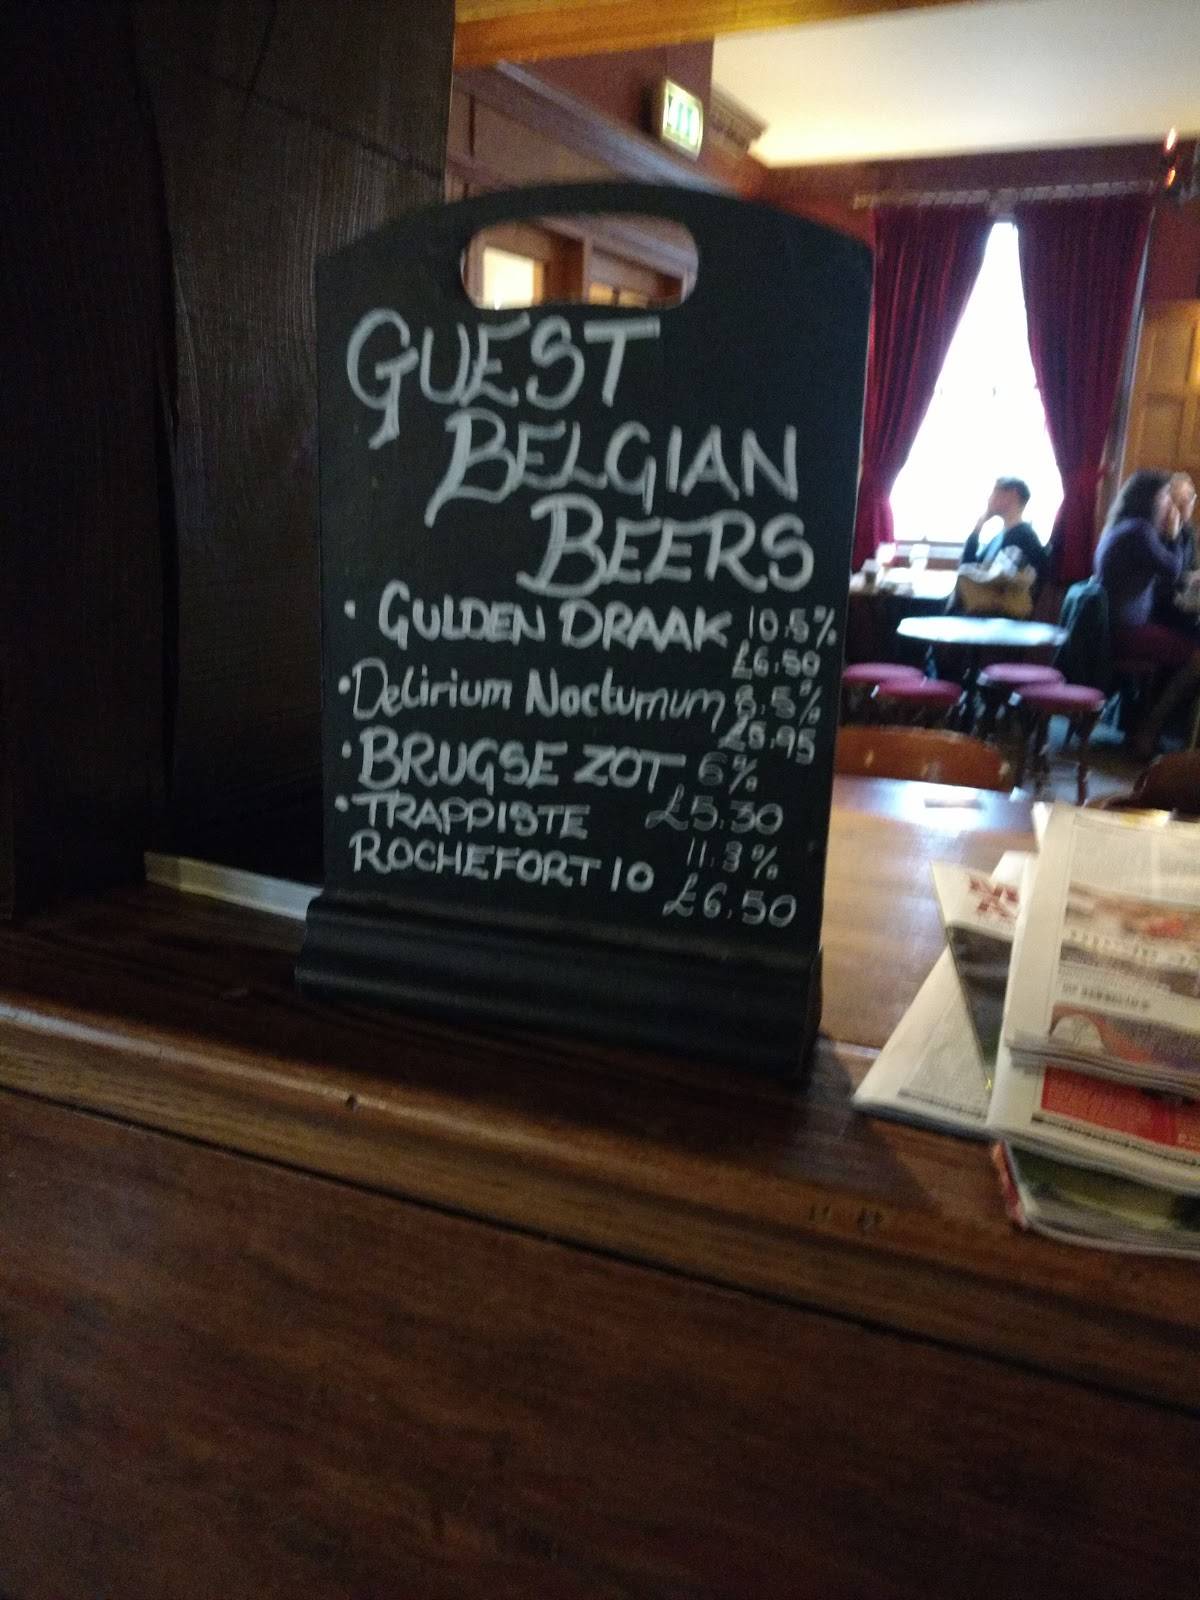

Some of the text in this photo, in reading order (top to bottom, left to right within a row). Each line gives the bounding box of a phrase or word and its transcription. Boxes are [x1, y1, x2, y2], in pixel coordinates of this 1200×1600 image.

[347, 308, 661, 450] GUEST
[424, 407, 799, 528] BELGIAN
[516, 492, 815, 598] BEERS
[378, 579, 837, 653] GULDEN DRAAK 10.5%
[352, 657, 513, 721] Delirium
[358, 725, 758, 796] BRUGSE ZOT 6%
[351, 783, 784, 840] TRAPPISTE £5.30
[349, 829, 602, 887] ROCHEFORT
[610, 856, 655, 893] 10
[661, 871, 797, 928] £6.50
